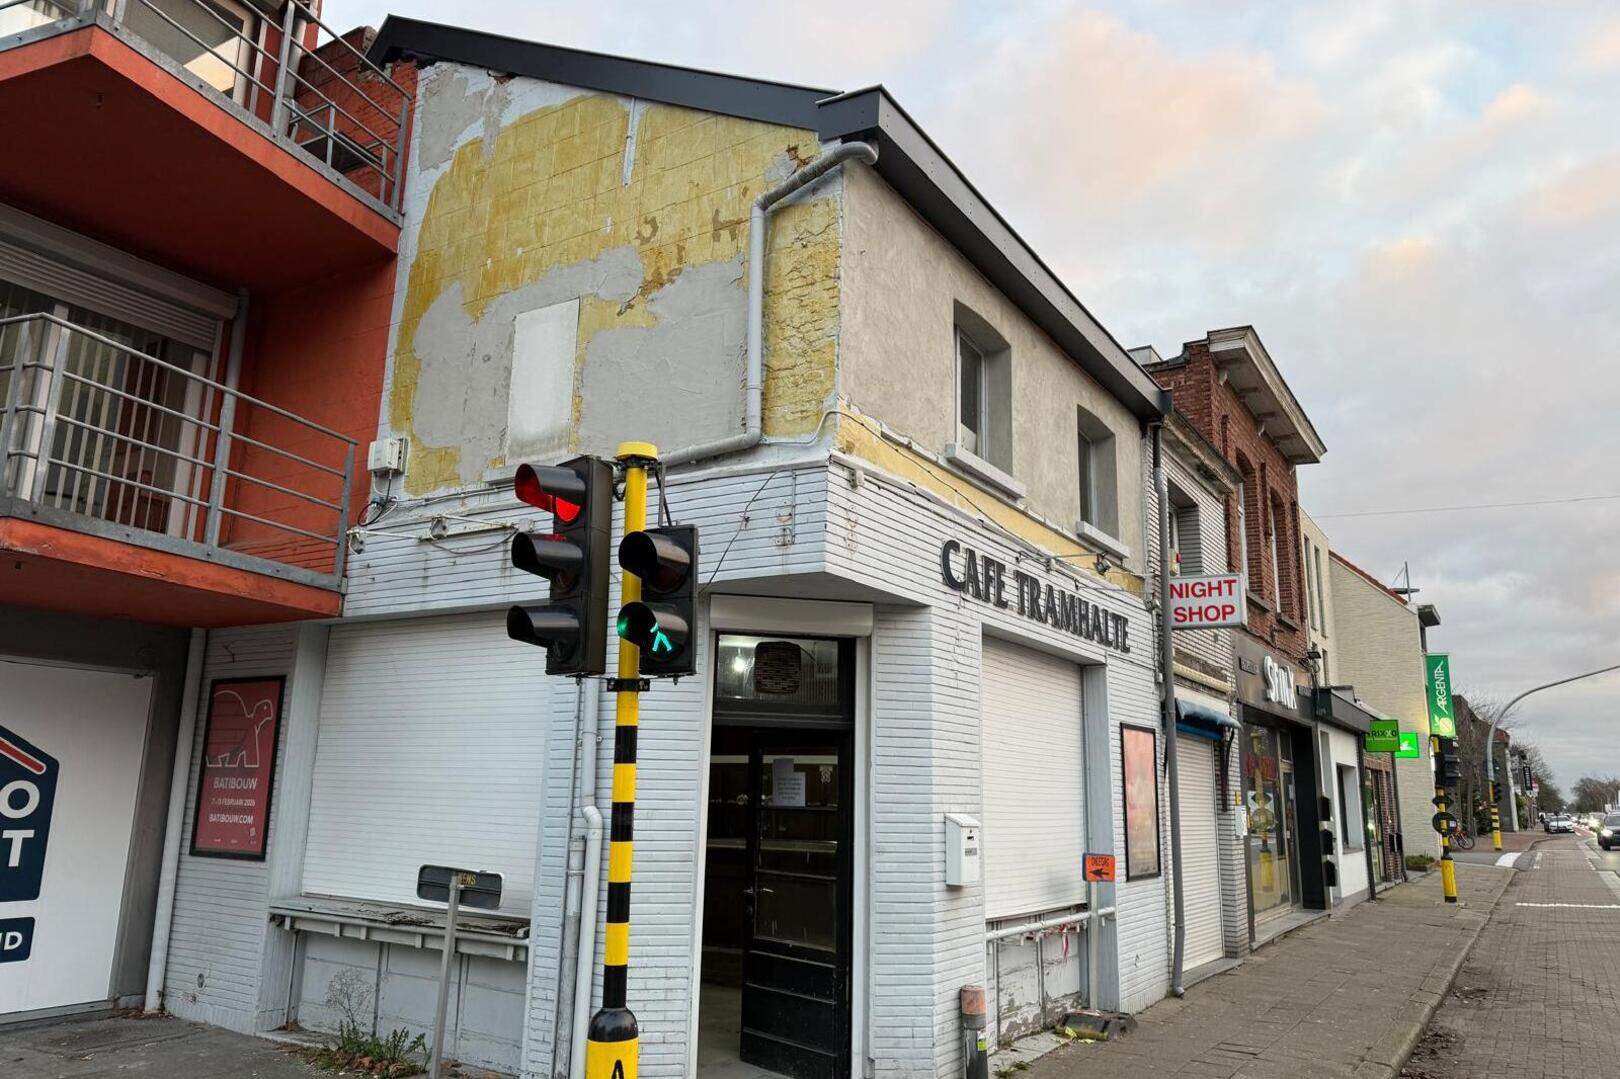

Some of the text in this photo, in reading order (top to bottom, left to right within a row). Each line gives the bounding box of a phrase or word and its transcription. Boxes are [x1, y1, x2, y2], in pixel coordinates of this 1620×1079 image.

[940, 539, 1131, 653] CAFE TRAMHALTE
[1169, 579, 1237, 599] NIGHT
[1174, 604, 1235, 622] SHOP
[1434, 660, 1449, 714] ARGENTA
[213, 776, 258, 790] BATIBOUW
[208, 813, 254, 825] BATIBOUW.COM
